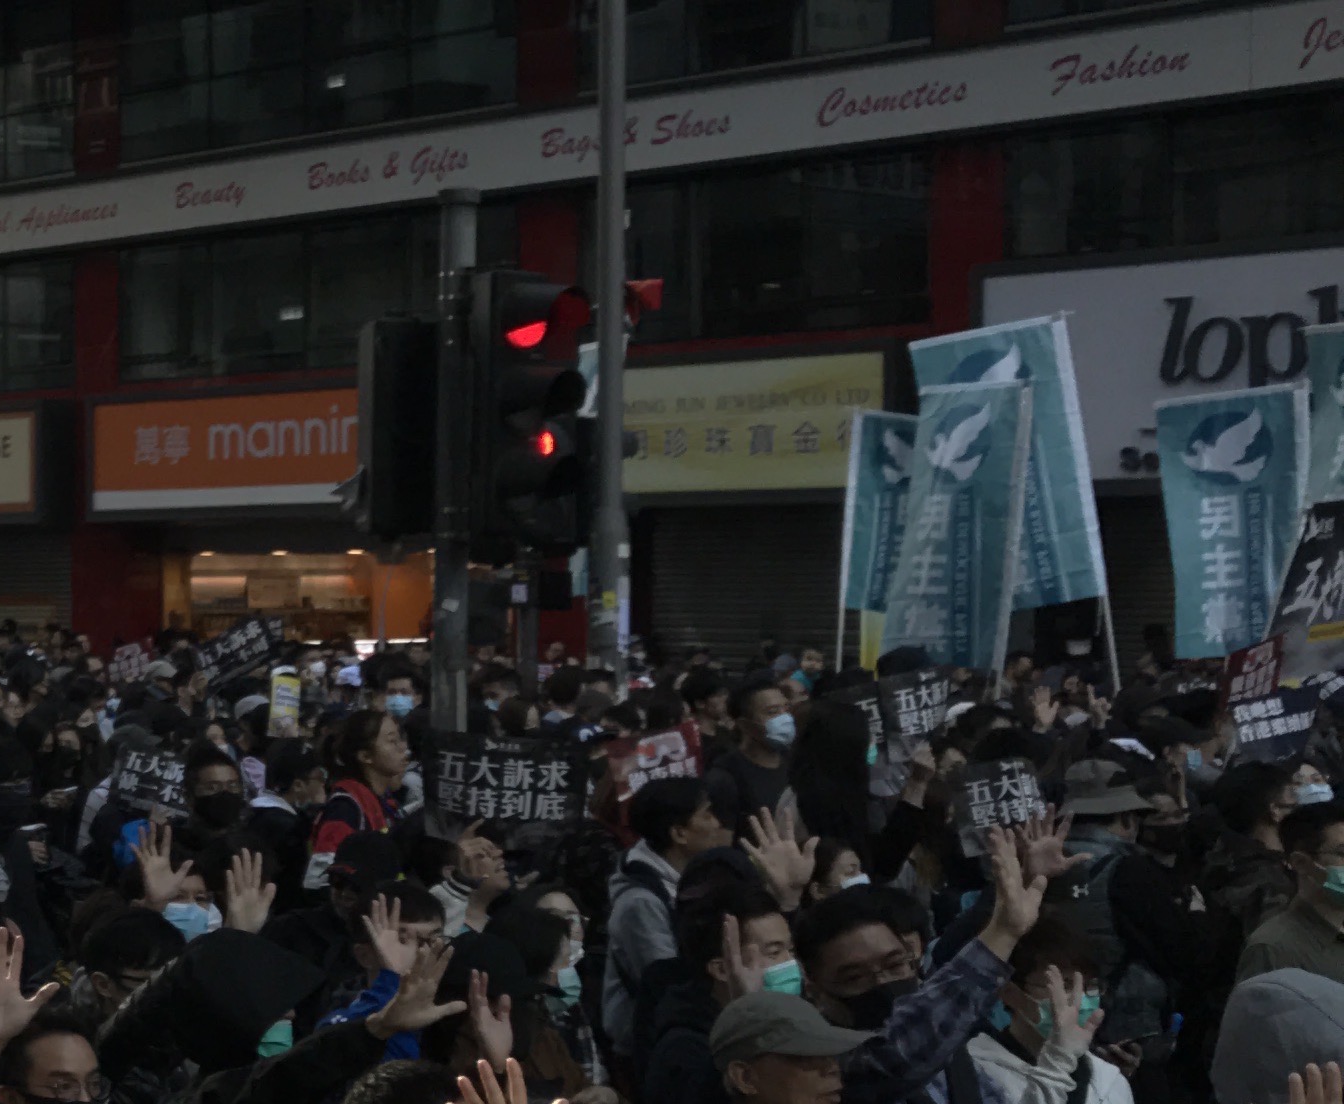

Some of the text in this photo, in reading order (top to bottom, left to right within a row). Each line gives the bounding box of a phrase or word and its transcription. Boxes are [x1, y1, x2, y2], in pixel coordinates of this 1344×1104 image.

[175, 180, 247, 210] Beauty
[307, 157, 371, 191] Books
[382, 156, 399, 180] &
[409, 145, 469, 187] Gifts
[650, 109, 731, 146] Shoes
[816, 82, 968, 128] Cosmetics
[1049, 45, 1191, 97] Fashion
[134, 423, 192, 465] 萬寧
[438, 751, 571, 791] 五大訴求
[438, 781, 567, 820] 堅持到底
